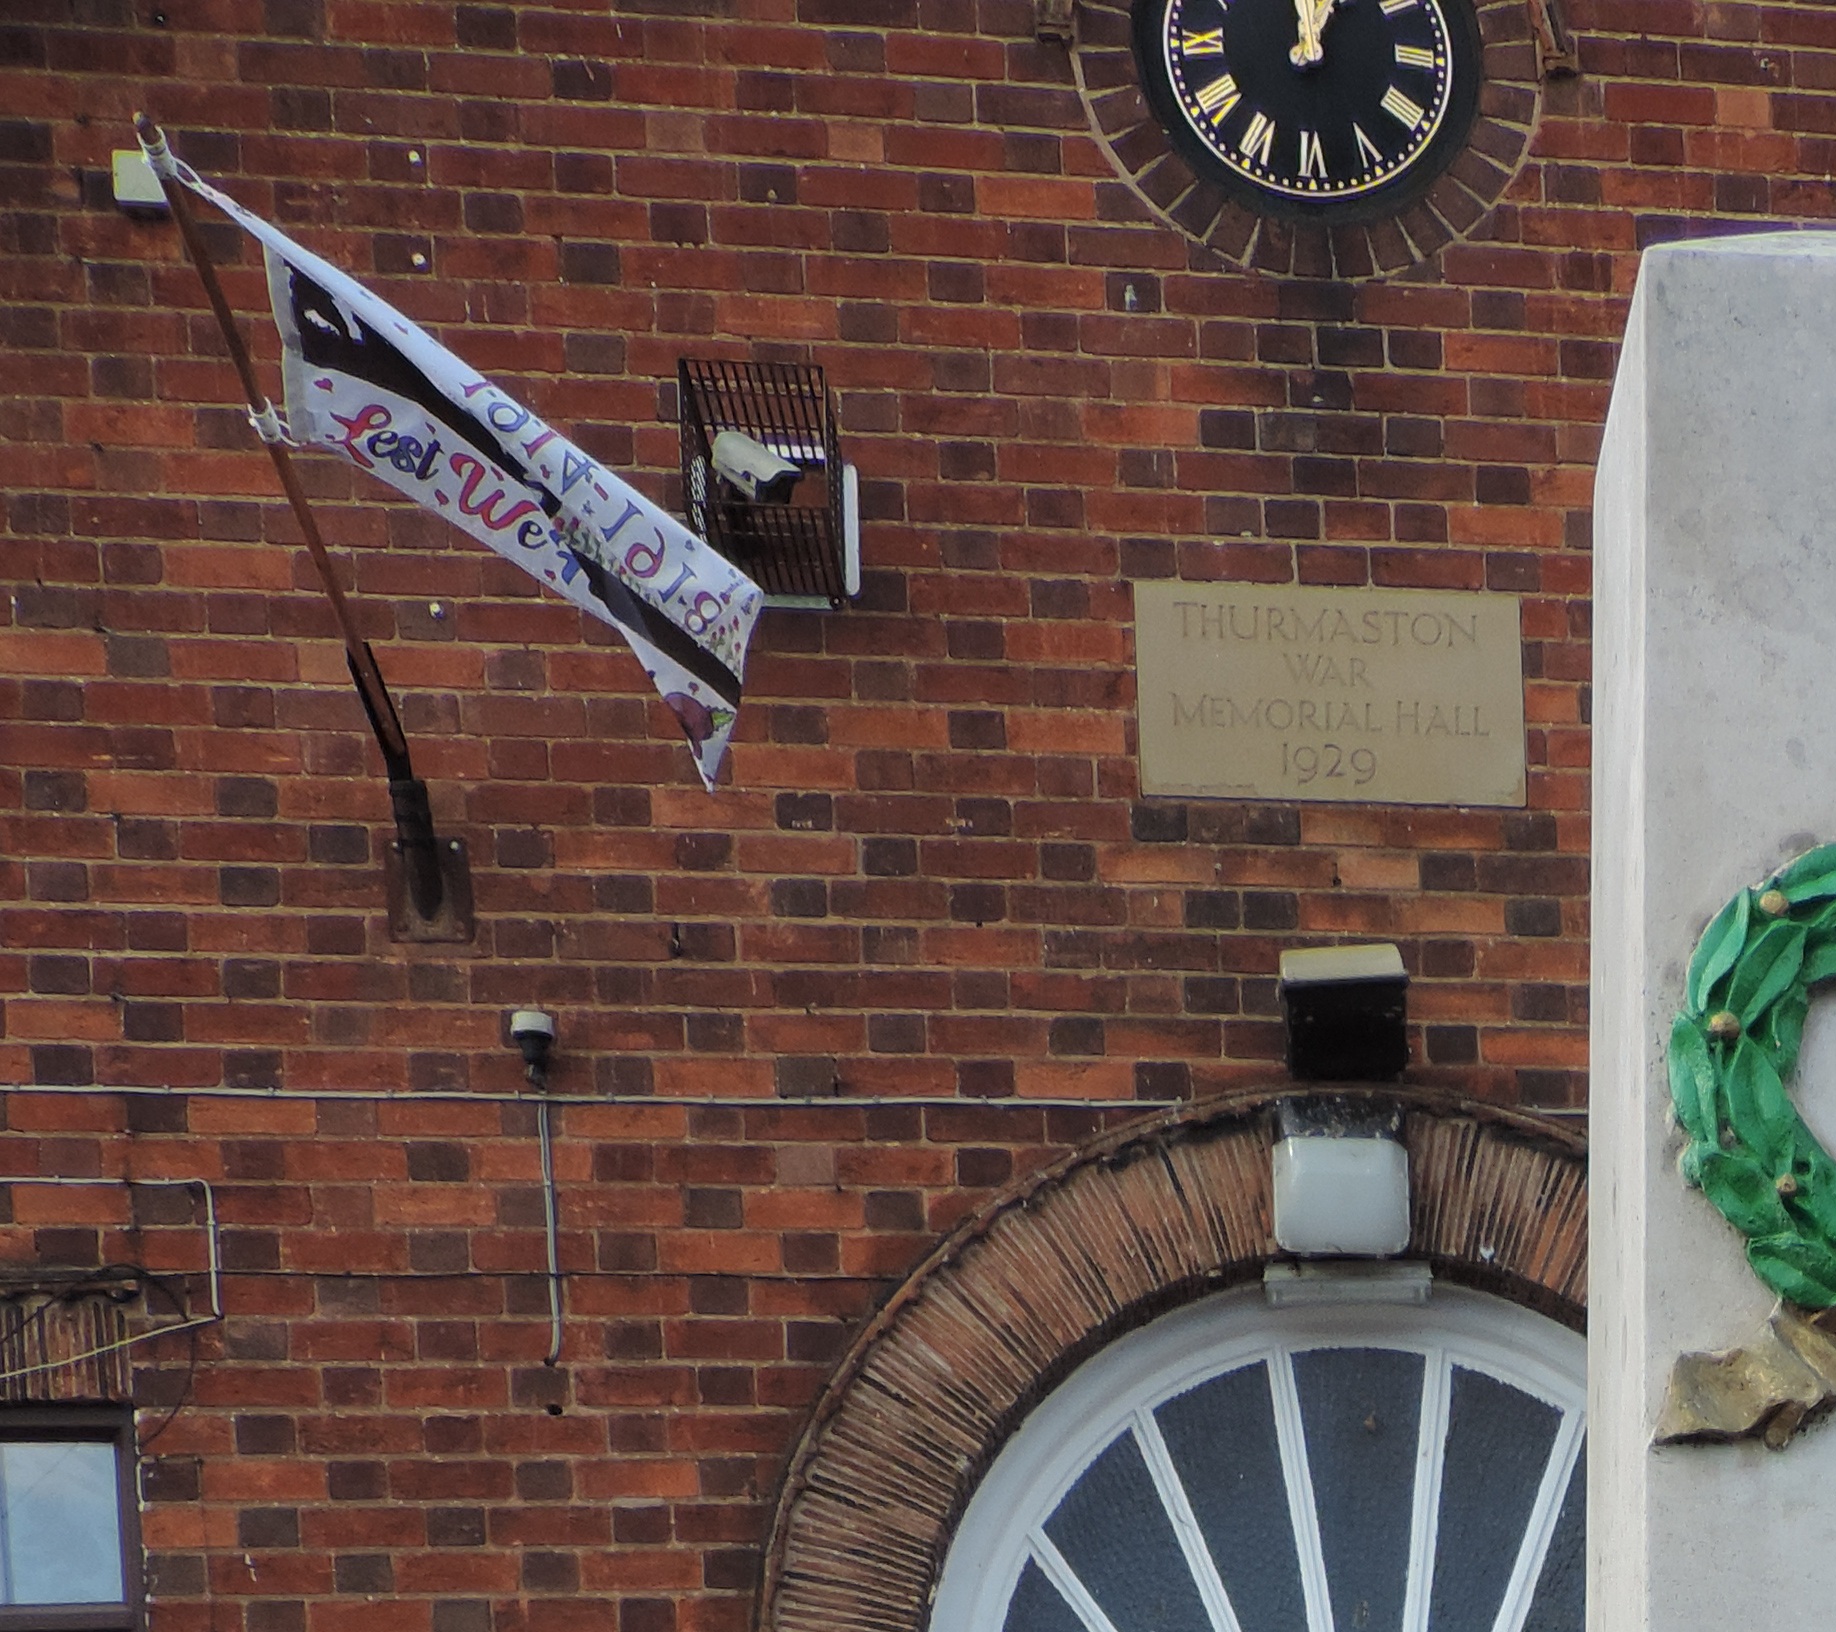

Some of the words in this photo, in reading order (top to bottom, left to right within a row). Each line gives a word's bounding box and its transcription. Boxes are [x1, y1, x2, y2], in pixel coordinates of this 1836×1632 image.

[328, 403, 446, 482] Lest
[449, 451, 549, 551] We
[1172, 601, 1479, 649] THURMASTON
[1282, 652, 1371, 689] WAR
[1168, 692, 1384, 732] MEMORIAL
[1397, 700, 1491, 738] HALL
[1281, 742, 1378, 786] 1929
